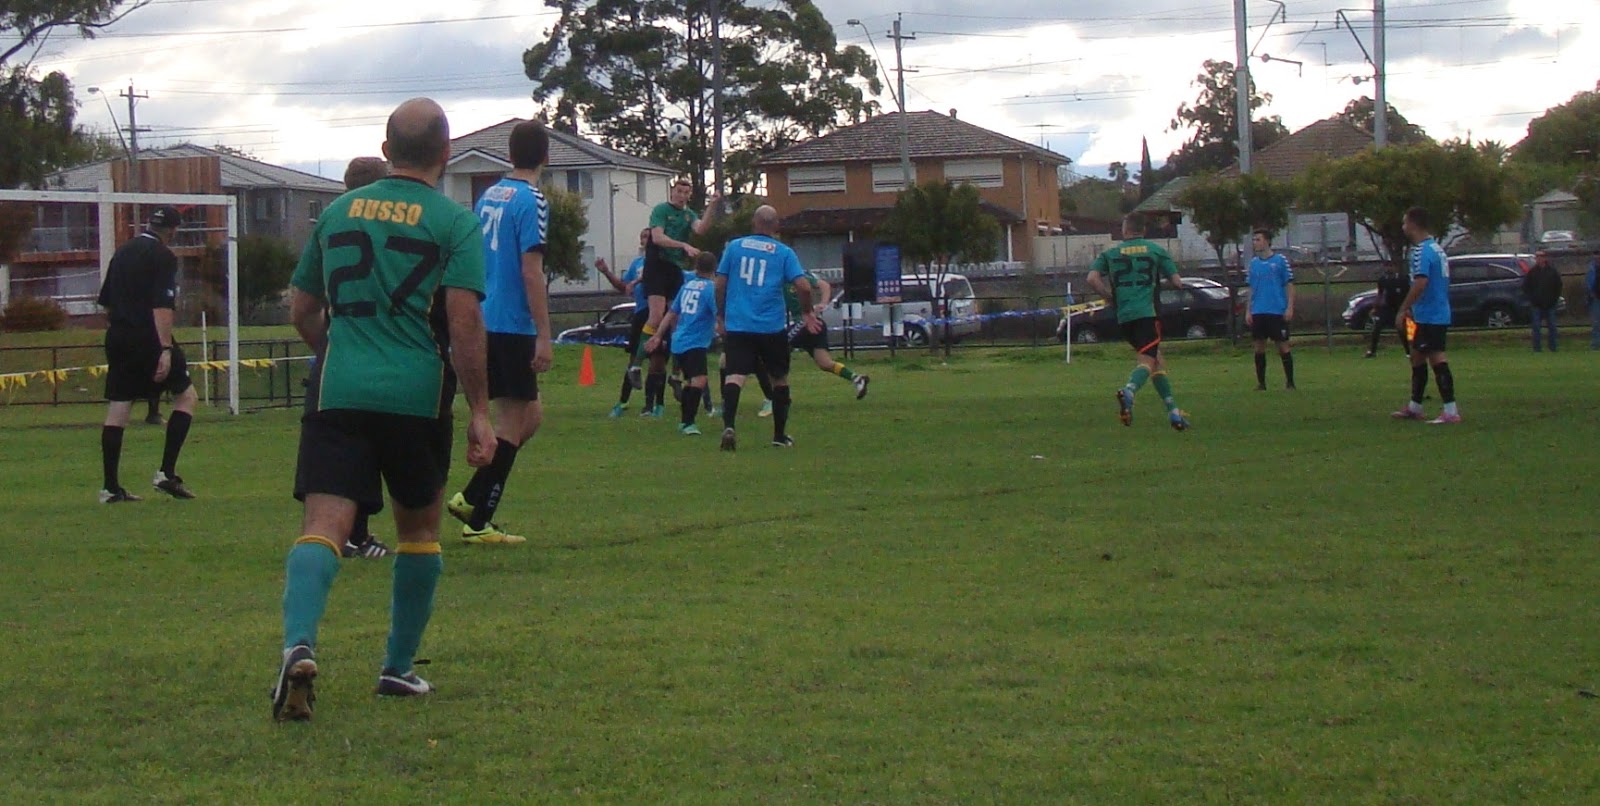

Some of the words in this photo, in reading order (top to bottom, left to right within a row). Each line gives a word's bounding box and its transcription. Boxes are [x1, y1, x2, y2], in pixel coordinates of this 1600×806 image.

[348, 198, 422, 226] RUSSO
[328, 231, 440, 317] 27
[740, 256, 767, 286] 41
[1114, 256, 1154, 287] 23
